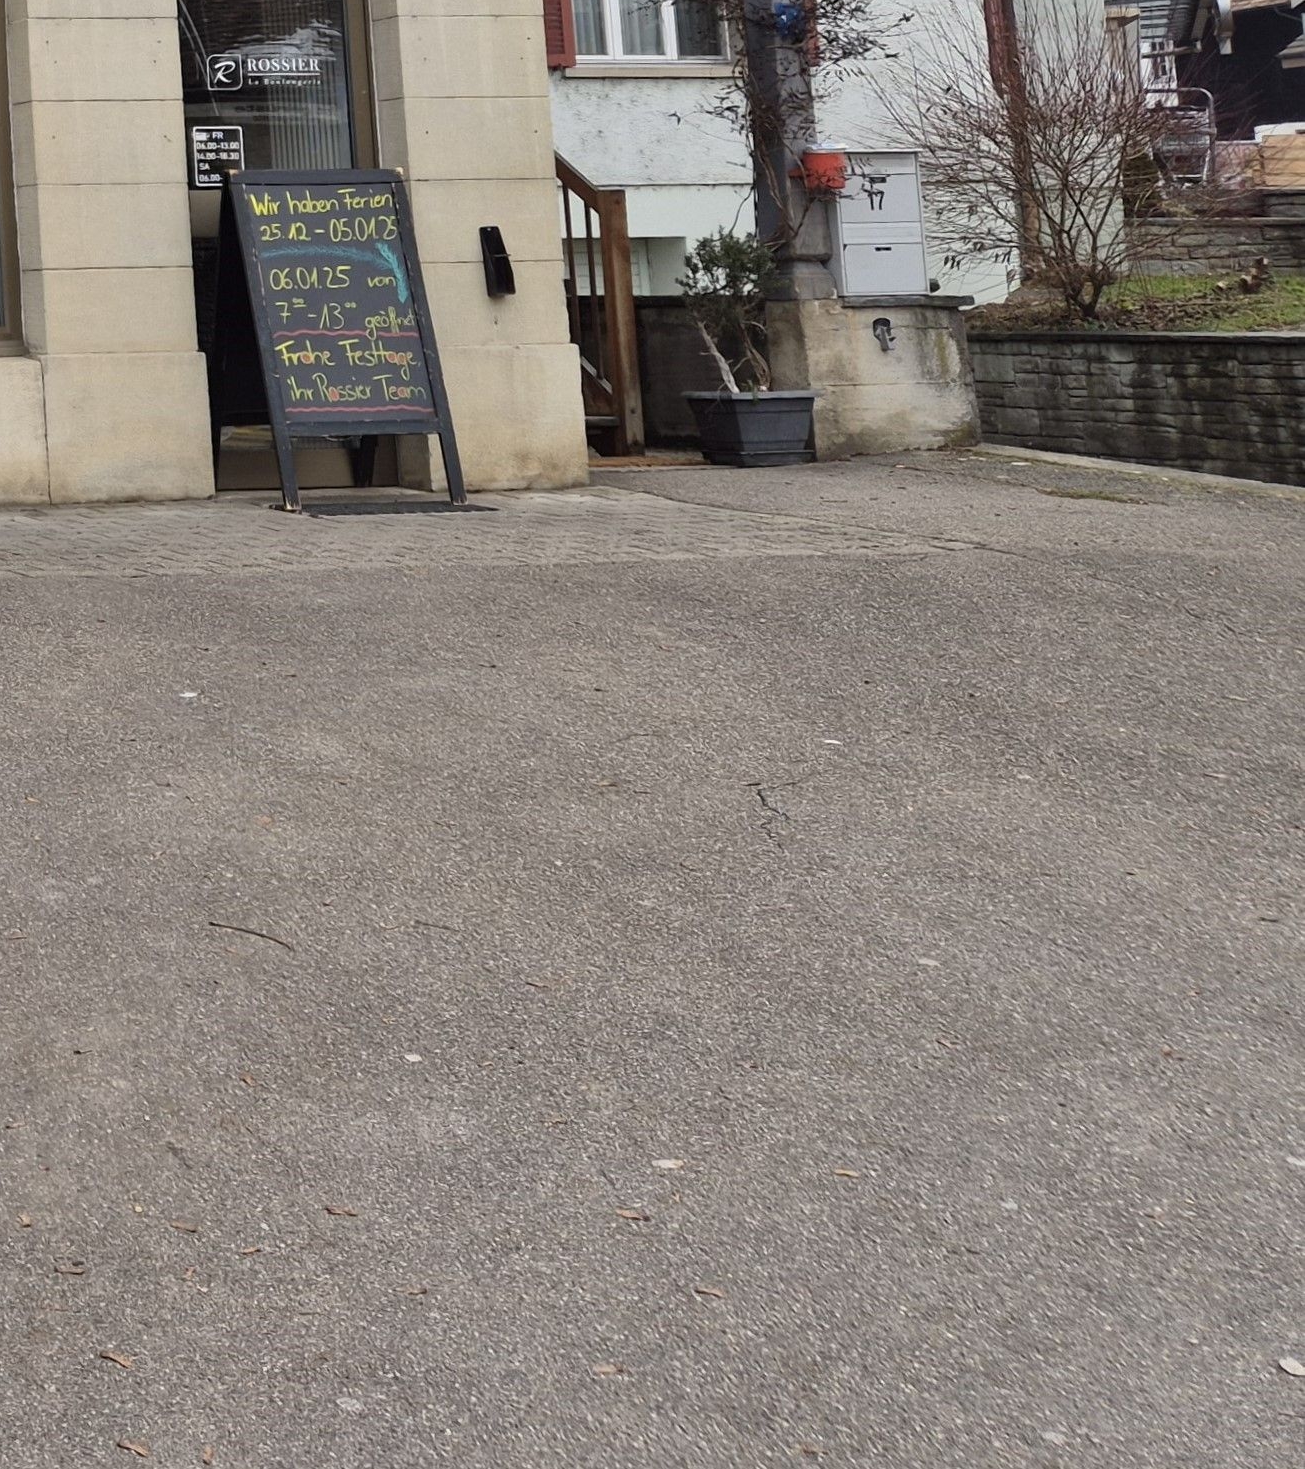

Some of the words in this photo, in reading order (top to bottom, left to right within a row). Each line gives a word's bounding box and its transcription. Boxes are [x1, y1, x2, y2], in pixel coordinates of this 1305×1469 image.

[214, 61, 236, 83] R
[247, 58, 321, 72] ROSSIER
[250, 193, 281, 216] Wir
[286, 190, 338, 214] haben
[337, 188, 392, 210] Ferien
[260, 222, 311, 240] 25.12
[270, 266, 351, 290] 06.01.25
[368, 276, 396, 287] von
[364, 306, 415, 340] geöffnet
[274, 340, 336, 366] Frohe
[312, 372, 371, 402] Rossier
[373, 375, 426, 401] Team
